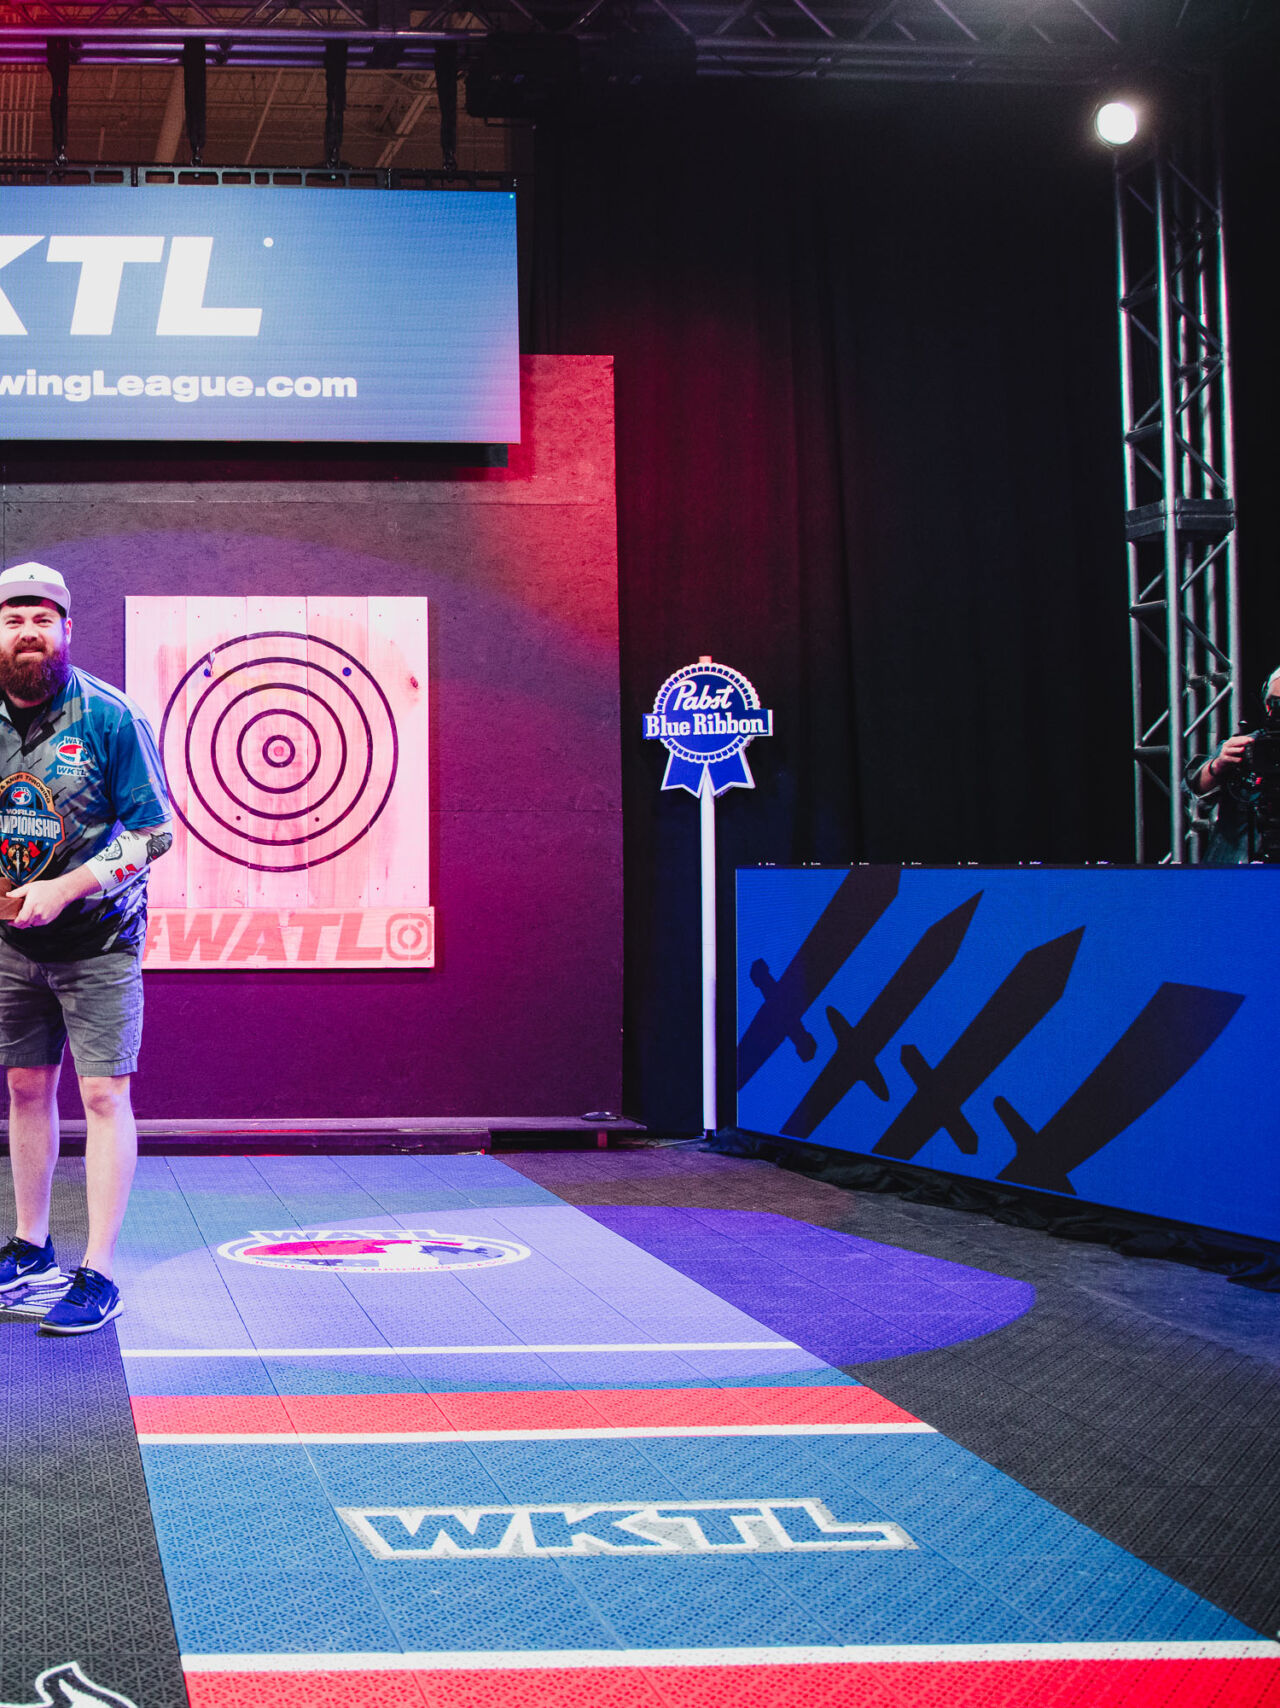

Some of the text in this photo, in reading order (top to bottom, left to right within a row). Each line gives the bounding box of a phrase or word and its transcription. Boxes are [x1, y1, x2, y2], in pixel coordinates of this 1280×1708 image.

[672, 680, 735, 711] Pabst
[645, 712, 768, 737] Blue Ribbon
[25, 774, 51, 804] THROWING
[257, 1230, 457, 1242] WATL
[348, 1502, 904, 1555] WKTL
